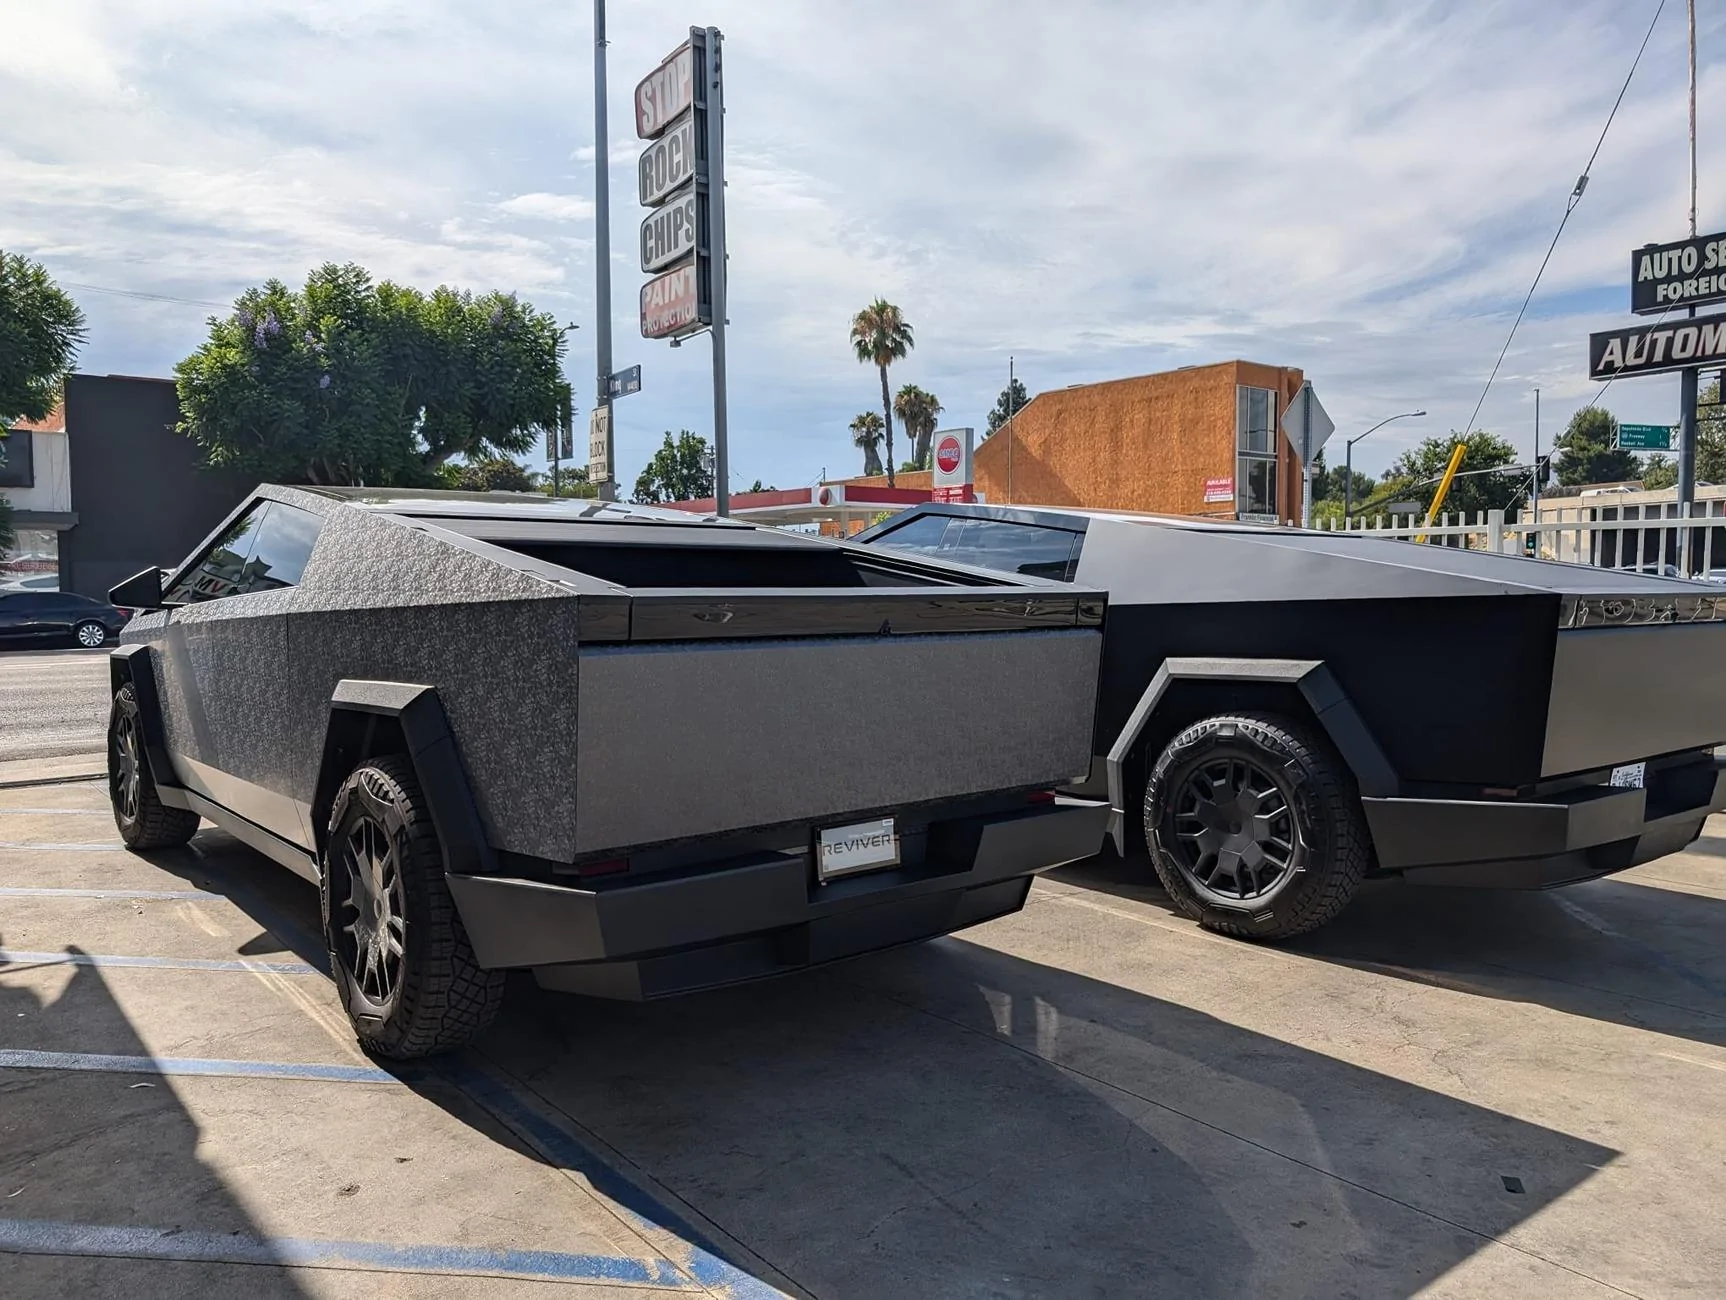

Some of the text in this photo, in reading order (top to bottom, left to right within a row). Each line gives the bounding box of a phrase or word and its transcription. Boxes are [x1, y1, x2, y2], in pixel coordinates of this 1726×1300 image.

[641, 59, 690, 128] STOP
[641, 127, 694, 198] ROCK
[643, 197, 694, 265] CHIPS
[1638, 246, 1698, 283] AUTO
[643, 267, 696, 310] PAINT
[1597, 323, 1726, 371] AUTOM
[595, 415, 606, 434] NOT
[590, 440, 606, 459] BLOCK
[823, 834, 891, 857] REVIVER
